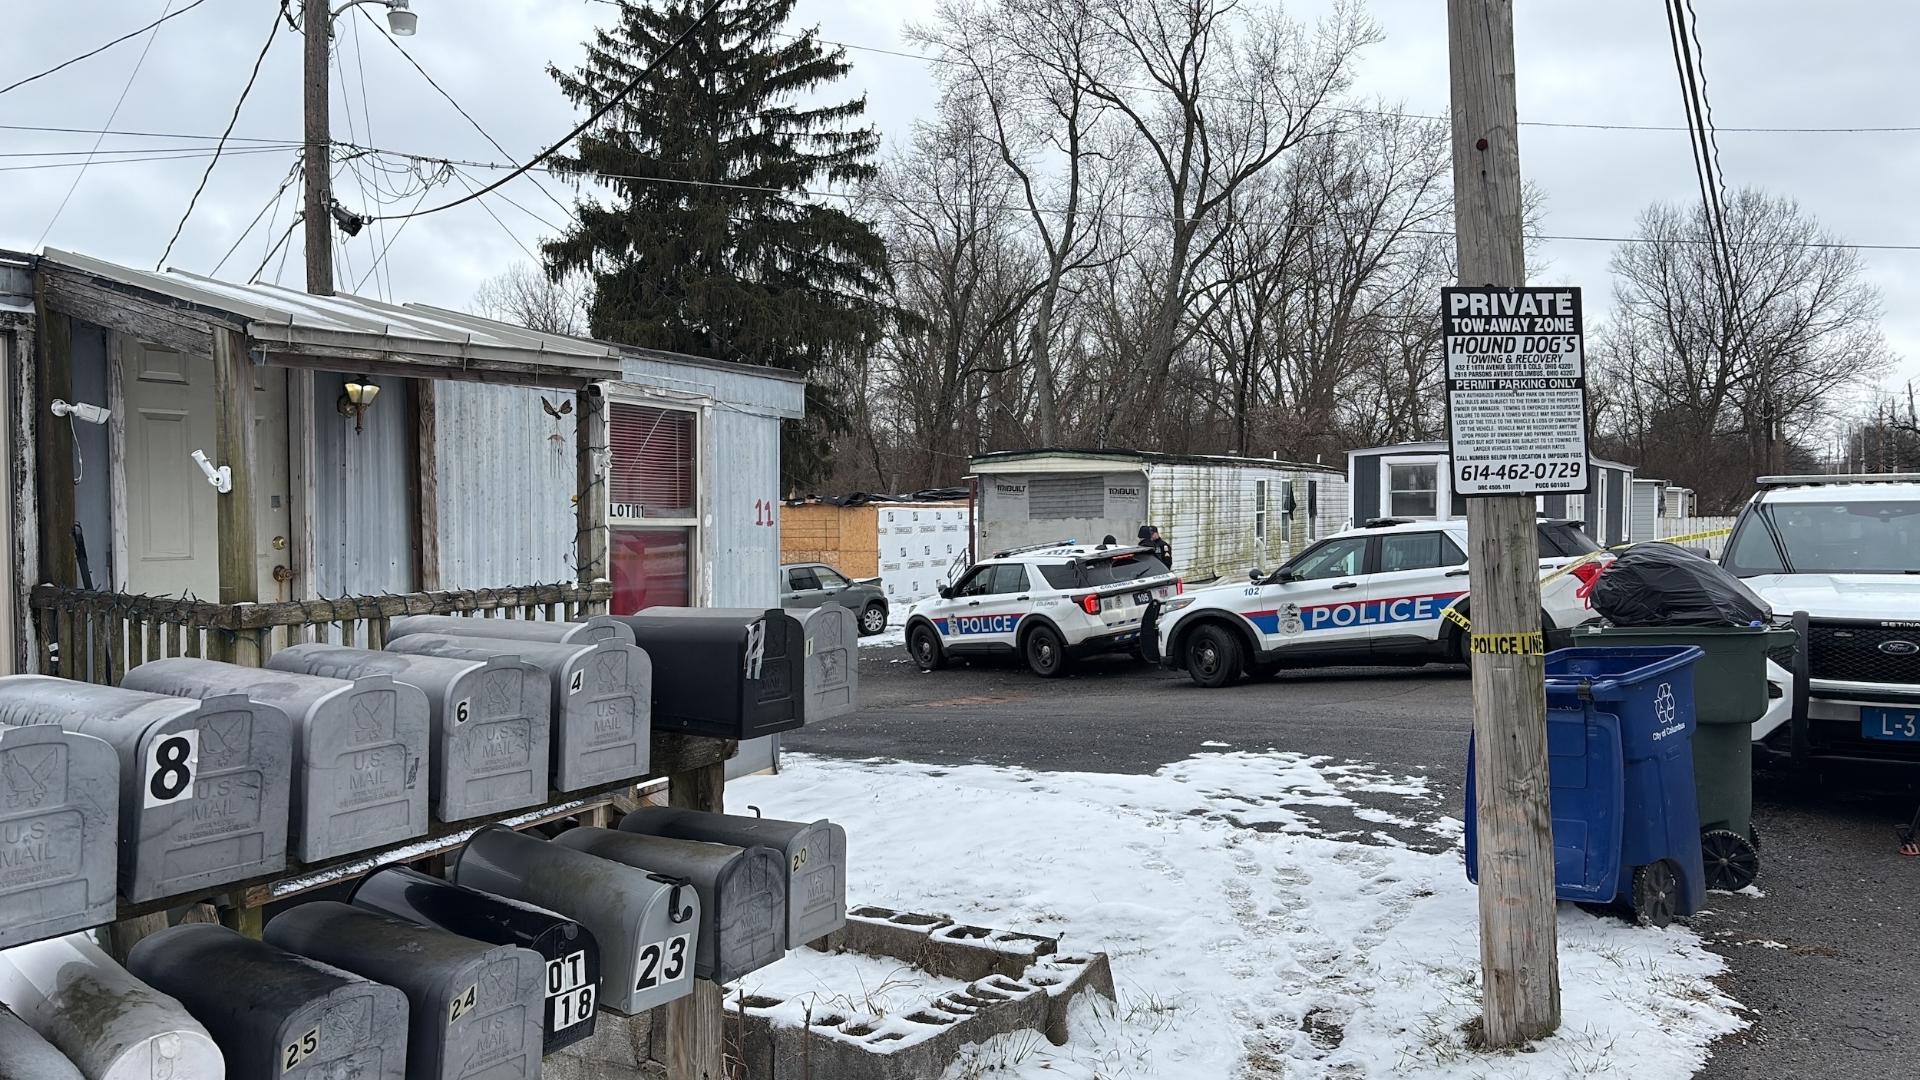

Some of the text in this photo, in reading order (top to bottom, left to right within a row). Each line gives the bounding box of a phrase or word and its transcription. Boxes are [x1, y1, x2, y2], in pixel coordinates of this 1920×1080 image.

[1450, 293, 1574, 316] PRIVATE
[1451, 317, 1575, 333] TOW-AWAY ZONE
[1452, 336, 1576, 354] HOUND DOG'S
[1466, 353, 1564, 364] TOWING & RECOVERY
[1456, 378, 1577, 390] PERMIT PARKING ONLY
[1461, 461, 1581, 481] 614-462-0729
[609, 504, 631, 518] LOT
[755, 498, 774, 527] 11
[1138, 593, 1149, 603] 105
[1244, 587, 1260, 597] 102
[1311, 597, 1434, 629] POLICE
[961, 615, 1012, 633] POLICE
[1474, 636, 1517, 655] POLICE
[1887, 643, 1911, 652] Ford
[571, 671, 582, 690] 4
[457, 701, 468, 722] 6
[594, 717, 621, 733] MAIL
[1652, 732, 1662, 741] City
[1666, 722, 1686, 736] Columbus
[1882, 713, 1916, 737] L-3
[482, 741, 514, 758] MAIL
[150, 737, 191, 800] 8
[350, 770, 391, 790] MAIL
[192, 799, 240, 821] MAIL
[793, 848, 807, 872] 20
[635, 936, 686, 991] 23
[548, 954, 581, 994] OT
[451, 985, 475, 1022] 24
[561, 988, 592, 1026] 18
[286, 1029, 317, 1070] 25
